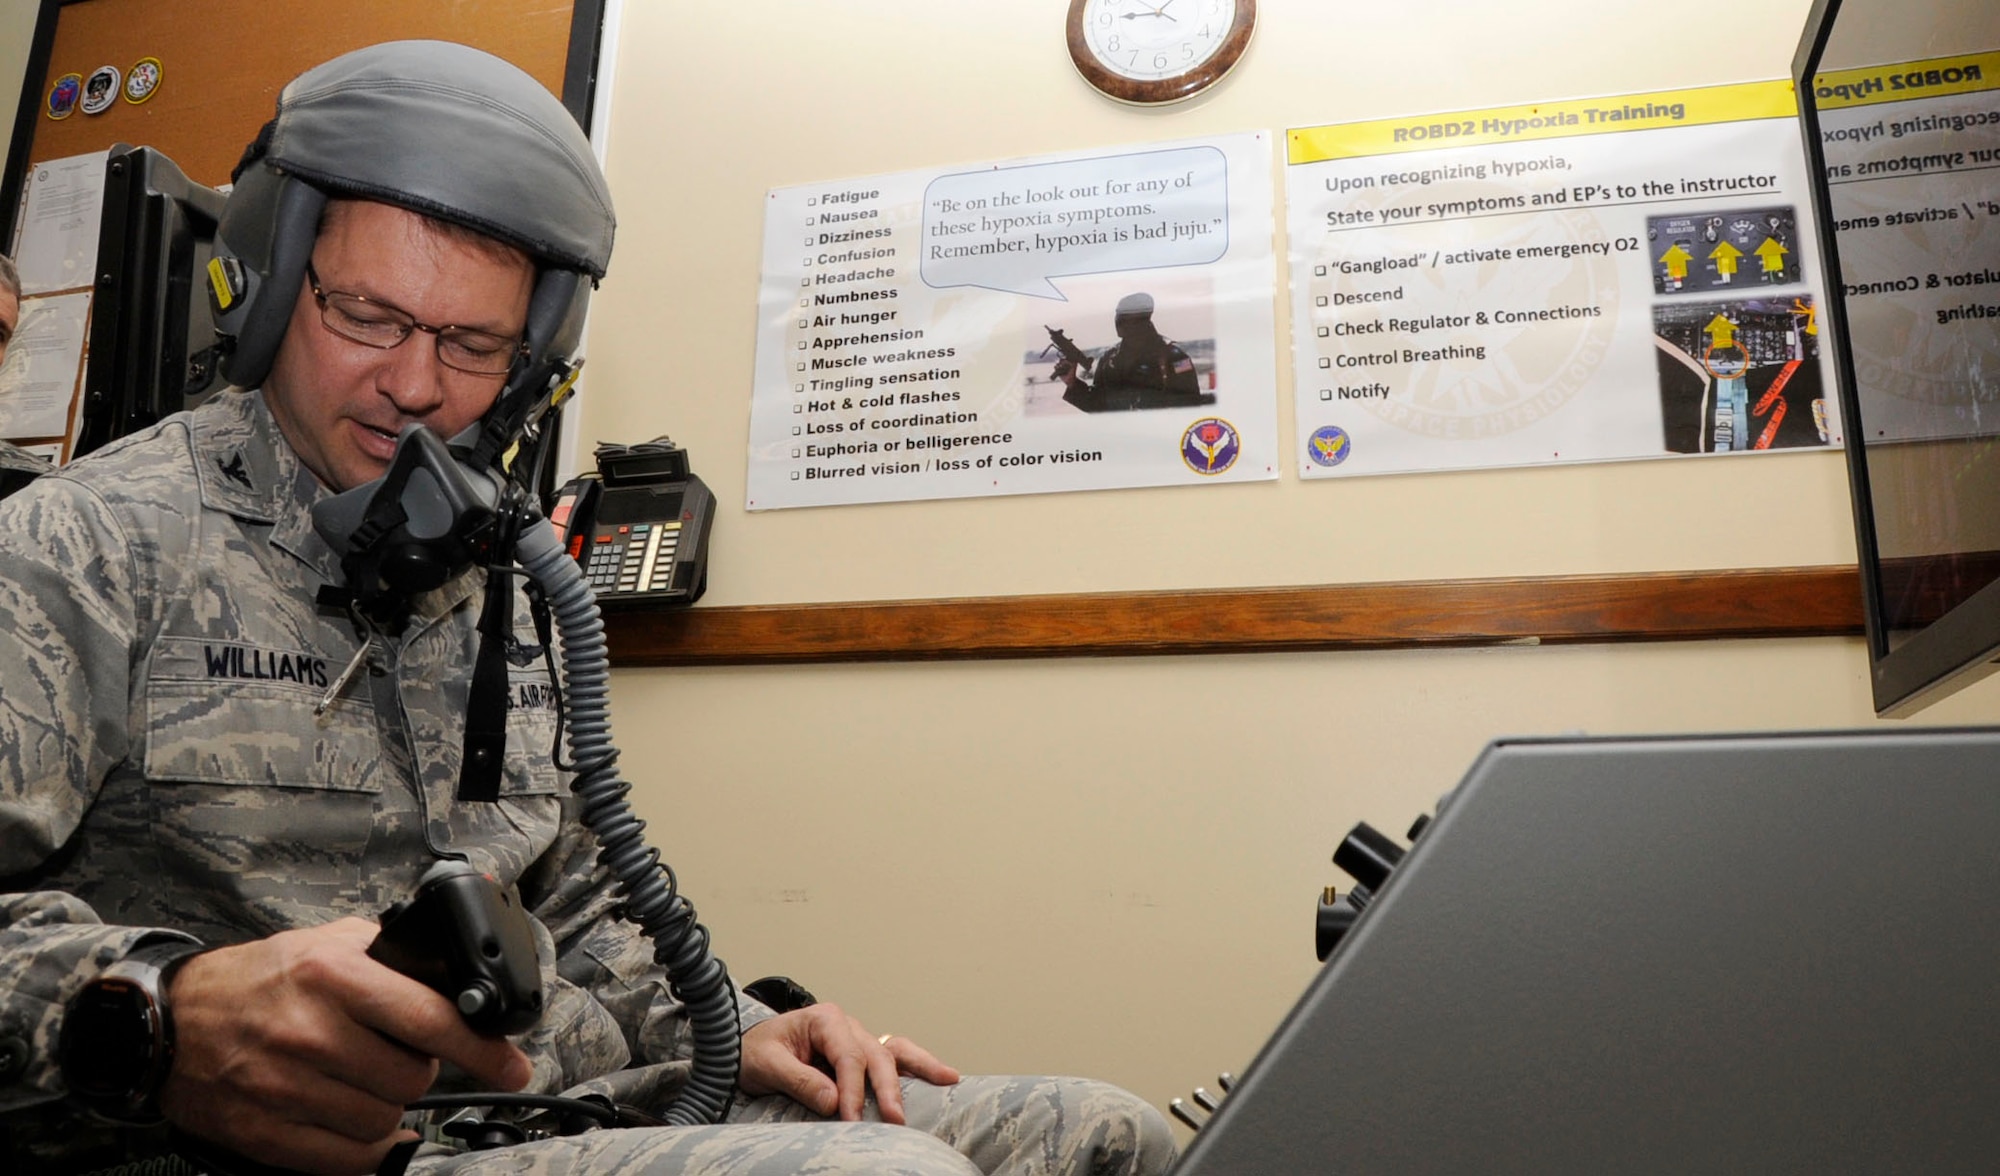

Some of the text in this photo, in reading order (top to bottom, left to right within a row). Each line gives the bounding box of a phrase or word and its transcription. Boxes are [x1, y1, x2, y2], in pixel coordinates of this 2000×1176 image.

[1099, 12, 1113, 29] 9
[1197, 23, 1210, 38] 4
[1108, 35, 1120, 53] 8
[1183, 43, 1194, 60] 5
[1129, 49, 1140, 67] 7
[1153, 51, 1168, 70] 6
[1394, 103, 1686, 142] ROBD2 Hypoxia Training
[1326, 155, 1573, 194] Upon recognizing hypoxia,
[821, 188, 880, 205] Fatigue
[932, 171, 1194, 213] “Be on the look out for any of
[1327, 209, 1374, 226] State
[1380, 204, 1423, 224] your
[1428, 194, 1526, 218] symptoms
[1531, 188, 1567, 206] and
[1616, 184, 1637, 198] to
[1642, 180, 1675, 196] the
[1680, 174, 1777, 194] instructor
[819, 209, 879, 225] Nausea
[931, 203, 1157, 237] these hypoxia symptoms.
[818, 227, 892, 245] Dizziness
[930, 235, 1030, 260] Remember,
[1035, 227, 1107, 253] hypoxia
[1113, 226, 1129, 242] is
[1134, 221, 1167, 241] bad
[817, 246, 896, 265] Confusion
[1431, 251, 1440, 268] /
[1445, 247, 1512, 265] activate
[1516, 239, 1611, 261] emergency
[1614, 237, 1639, 252] O2
[815, 267, 896, 286] Headache
[814, 287, 899, 307] Numbness
[1333, 286, 1404, 306] Descend
[813, 309, 898, 329] Air hunger
[1334, 304, 1602, 336] Check Regulator & Connections
[812, 328, 924, 351] Apprehension
[811, 347, 956, 371] Muscle weakness
[1336, 344, 1486, 368] Control Breathing
[810, 368, 961, 393] Tingling sensation
[1337, 382, 1391, 401] Notify
[808, 390, 961, 414] Hot & cold flashes
[806, 410, 978, 435] Loss of coordination
[806, 431, 1013, 459] Euphoria or belligerence
[805, 449, 1103, 480] Blurred vision / loss of color vision
[204, 645, 328, 688] WILLIAMS
